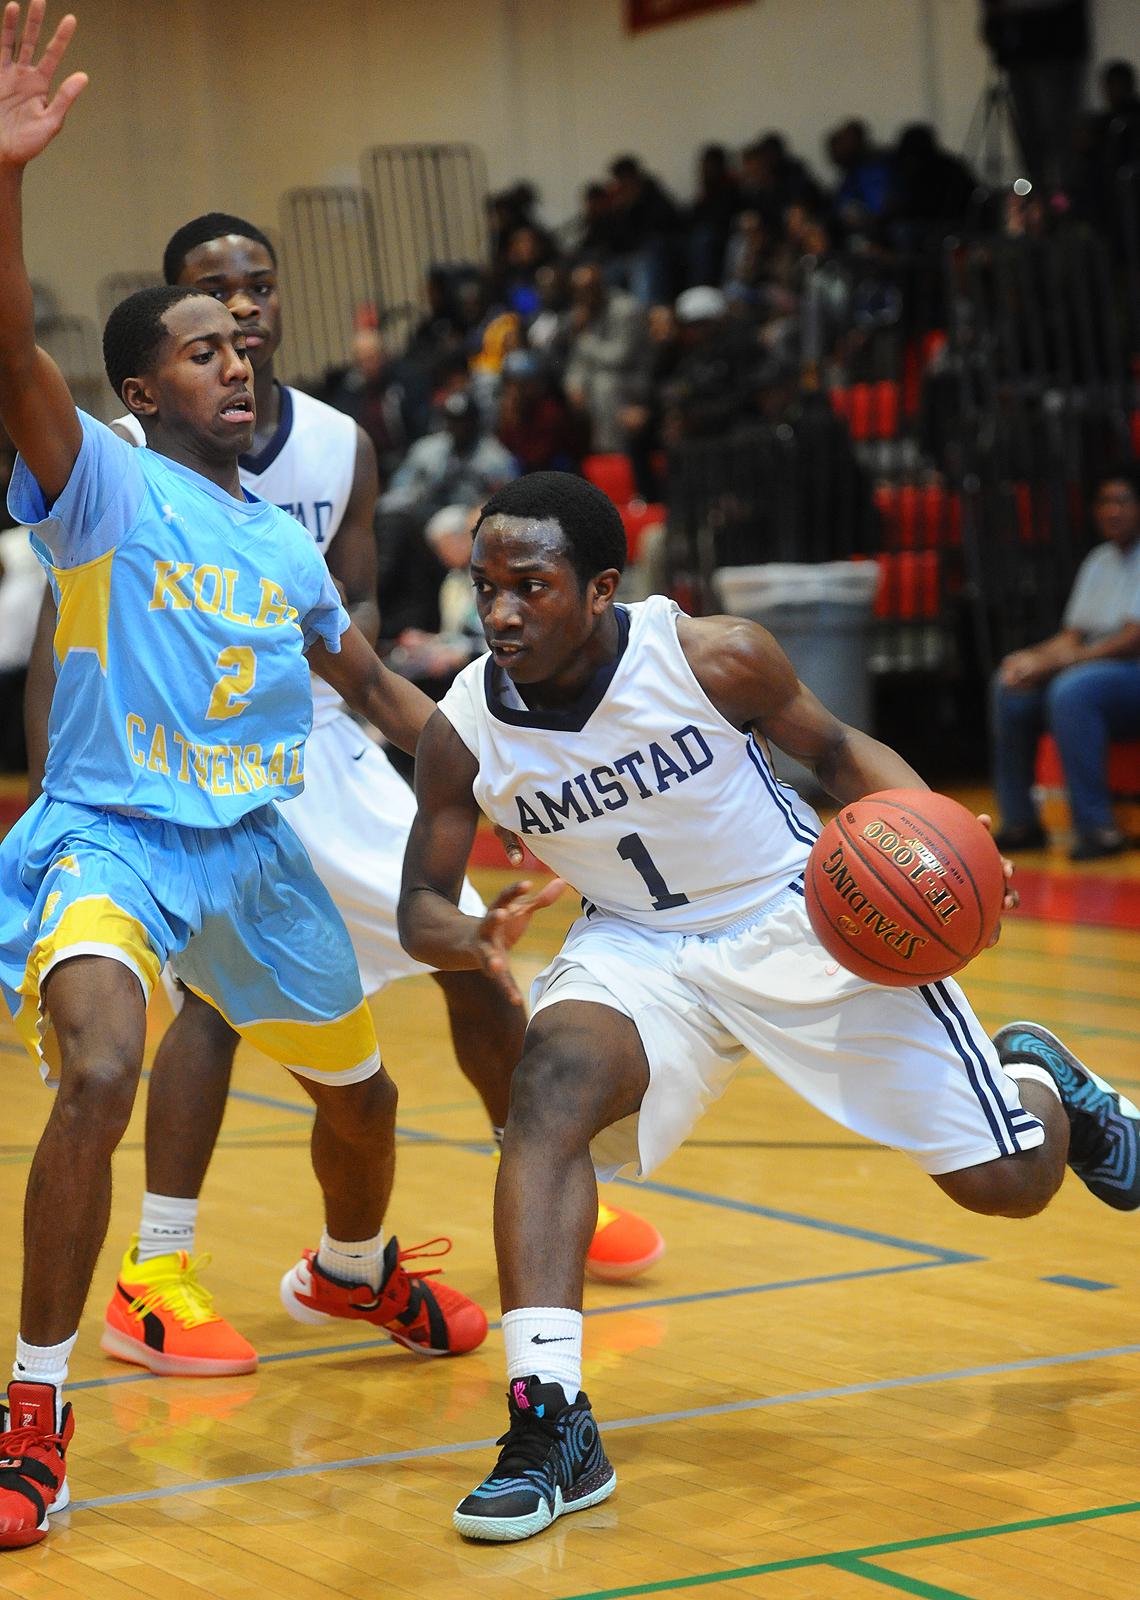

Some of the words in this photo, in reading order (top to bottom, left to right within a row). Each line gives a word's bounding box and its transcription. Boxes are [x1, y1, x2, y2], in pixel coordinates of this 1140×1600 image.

[205, 646, 257, 720] 2
[514, 724, 714, 834] AMISTAD
[617, 832, 690, 911] 1
[822, 847, 929, 960] SPALDING
[863, 820, 961, 927] TF-1000
